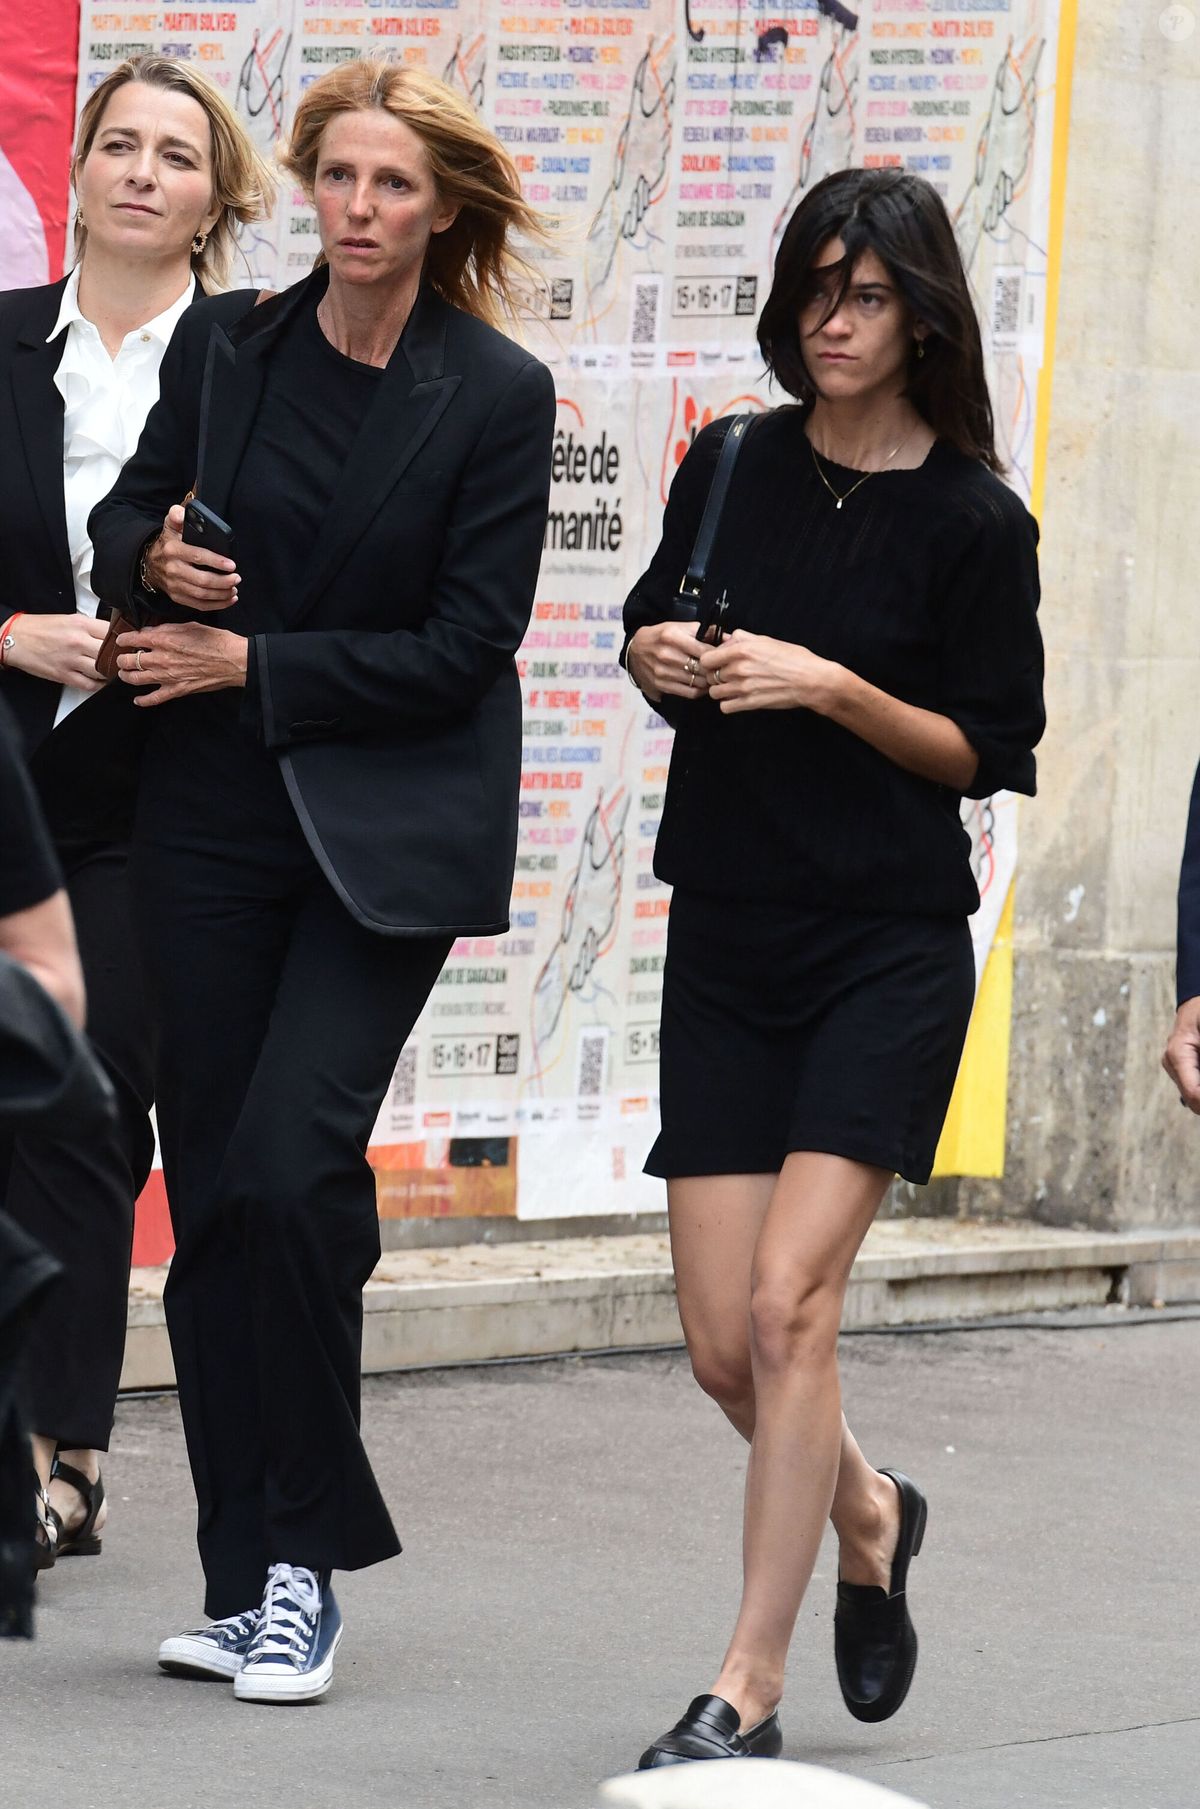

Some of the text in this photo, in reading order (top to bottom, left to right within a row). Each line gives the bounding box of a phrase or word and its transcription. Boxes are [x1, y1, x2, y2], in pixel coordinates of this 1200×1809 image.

[551, 430, 620, 484] ête de
[543, 498, 622, 551] manité
[433, 1044, 444, 1067] 15
[477, 1043, 490, 1066] 17
